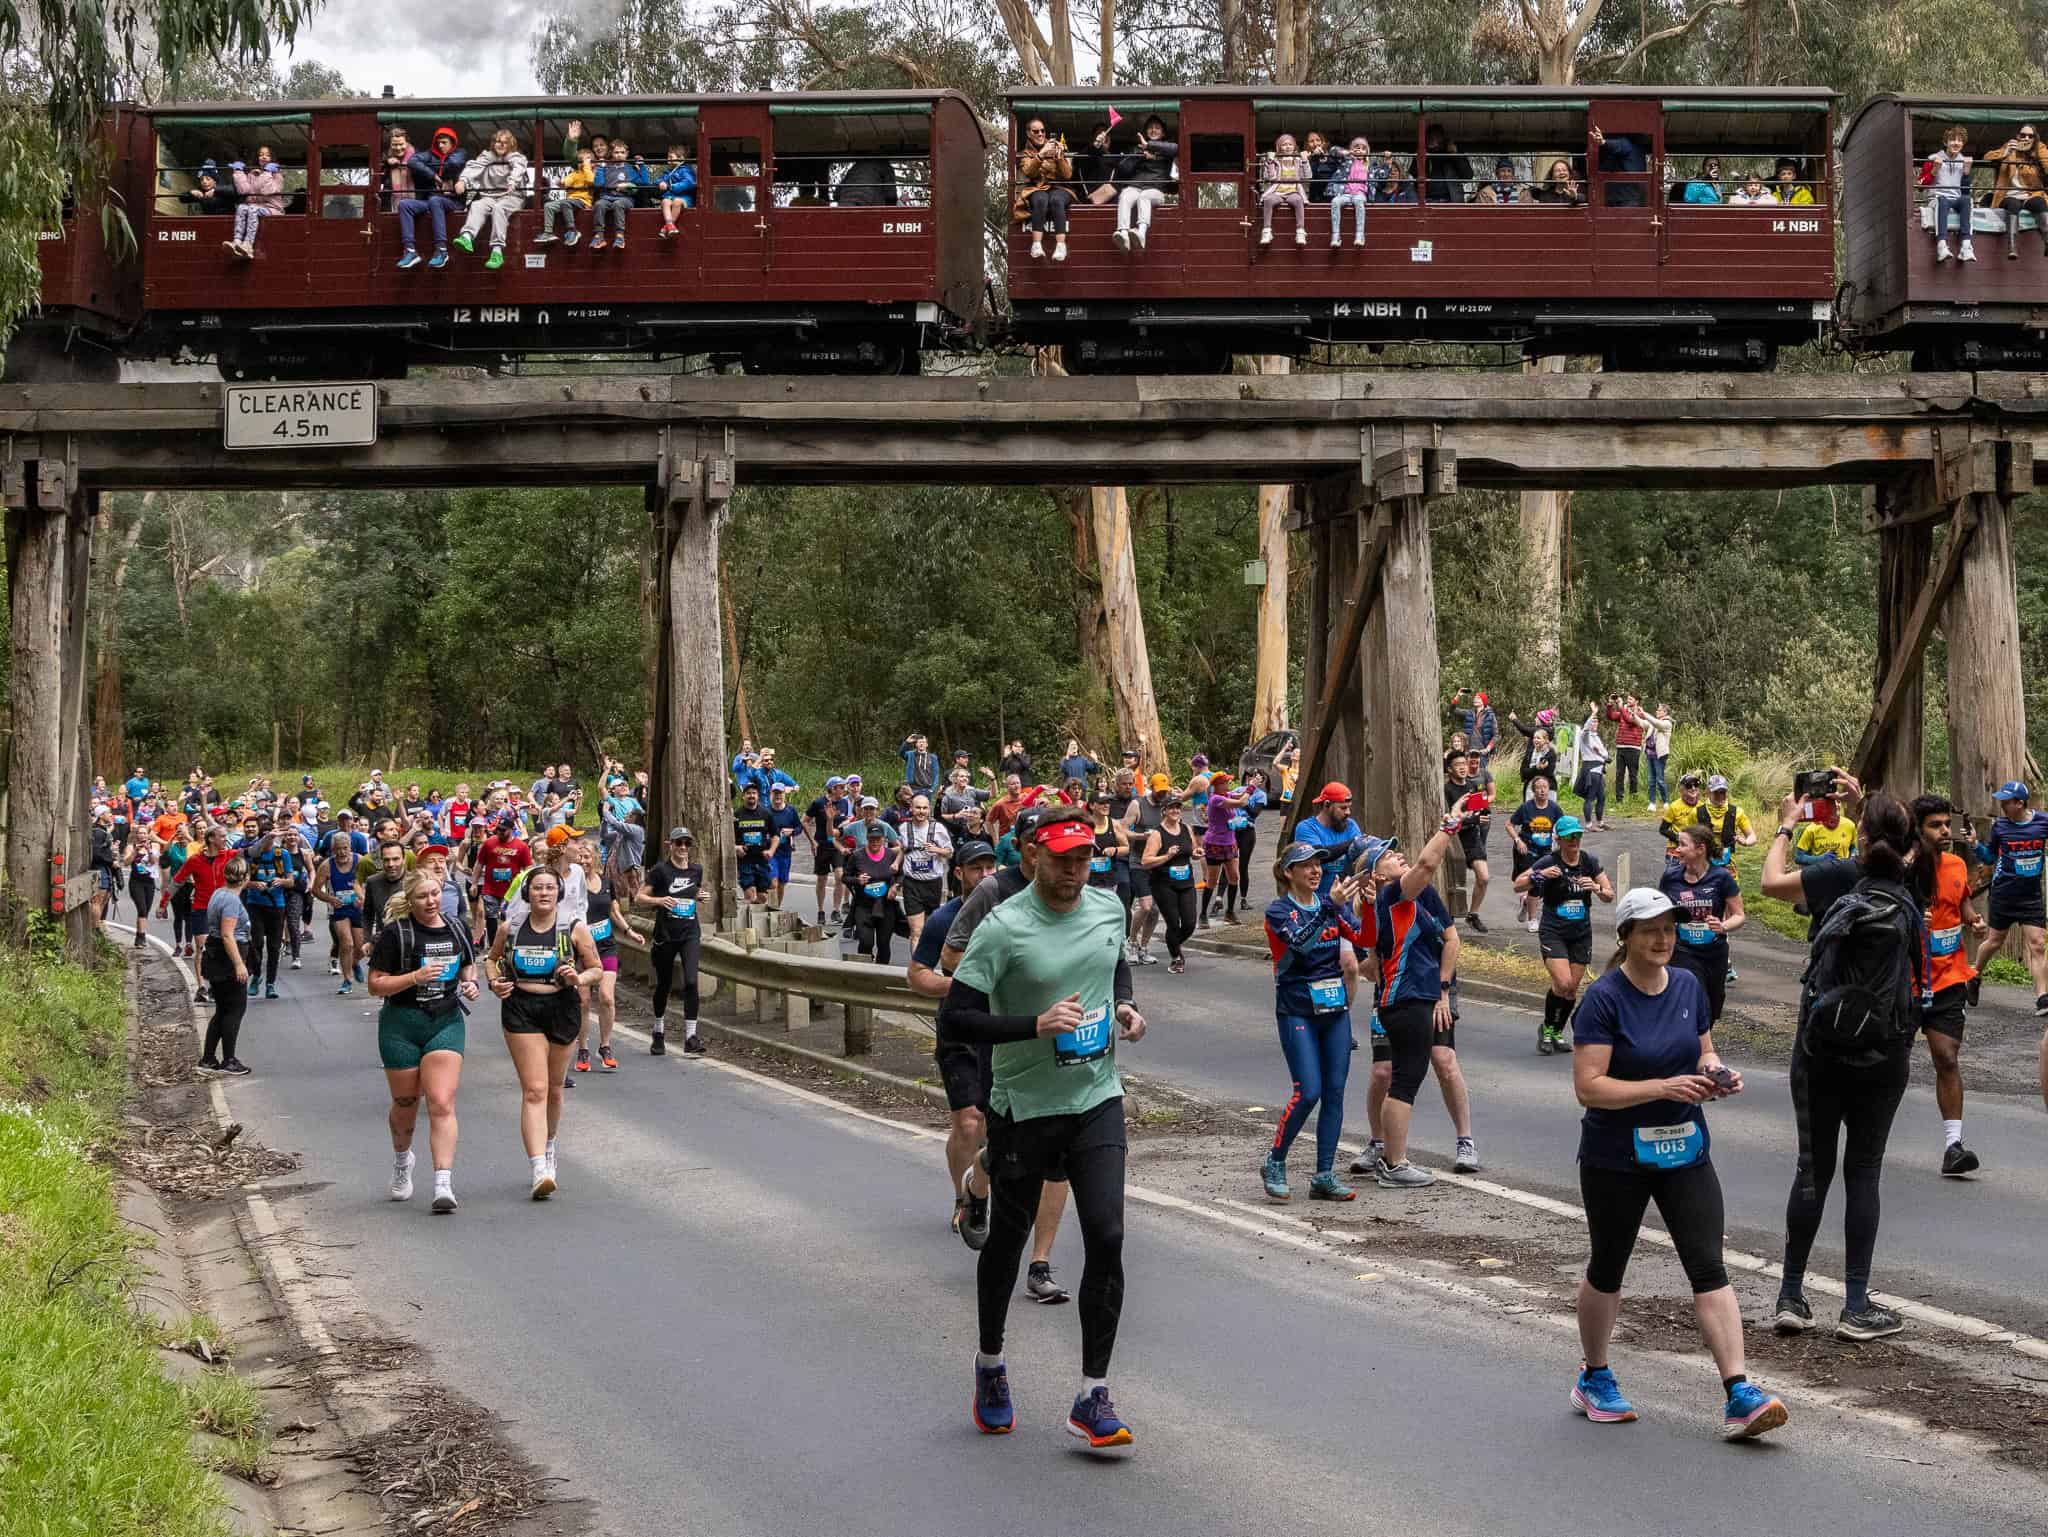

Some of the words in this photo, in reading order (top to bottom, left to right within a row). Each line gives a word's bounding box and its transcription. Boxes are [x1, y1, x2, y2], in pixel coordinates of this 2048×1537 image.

[882, 223, 894, 233] 12
[896, 223, 922, 233] NBH
[1772, 221, 1786, 232] 14
[1788, 221, 1819, 232] NBH
[158, 231, 169, 241] 12
[171, 231, 196, 241] NBH
[453, 309, 471, 323] 12
[480, 308, 520, 323] NBH
[1333, 303, 1351, 317] 14
[1363, 303, 1401, 317] NBH
[238, 391, 362, 415] CLEARANCE
[272, 419, 329, 438] 4.5m
[674, 877, 691, 887] NIKE
[1075, 1024, 1099, 1041] 1177
[1654, 1139, 1686, 1154] 1013
